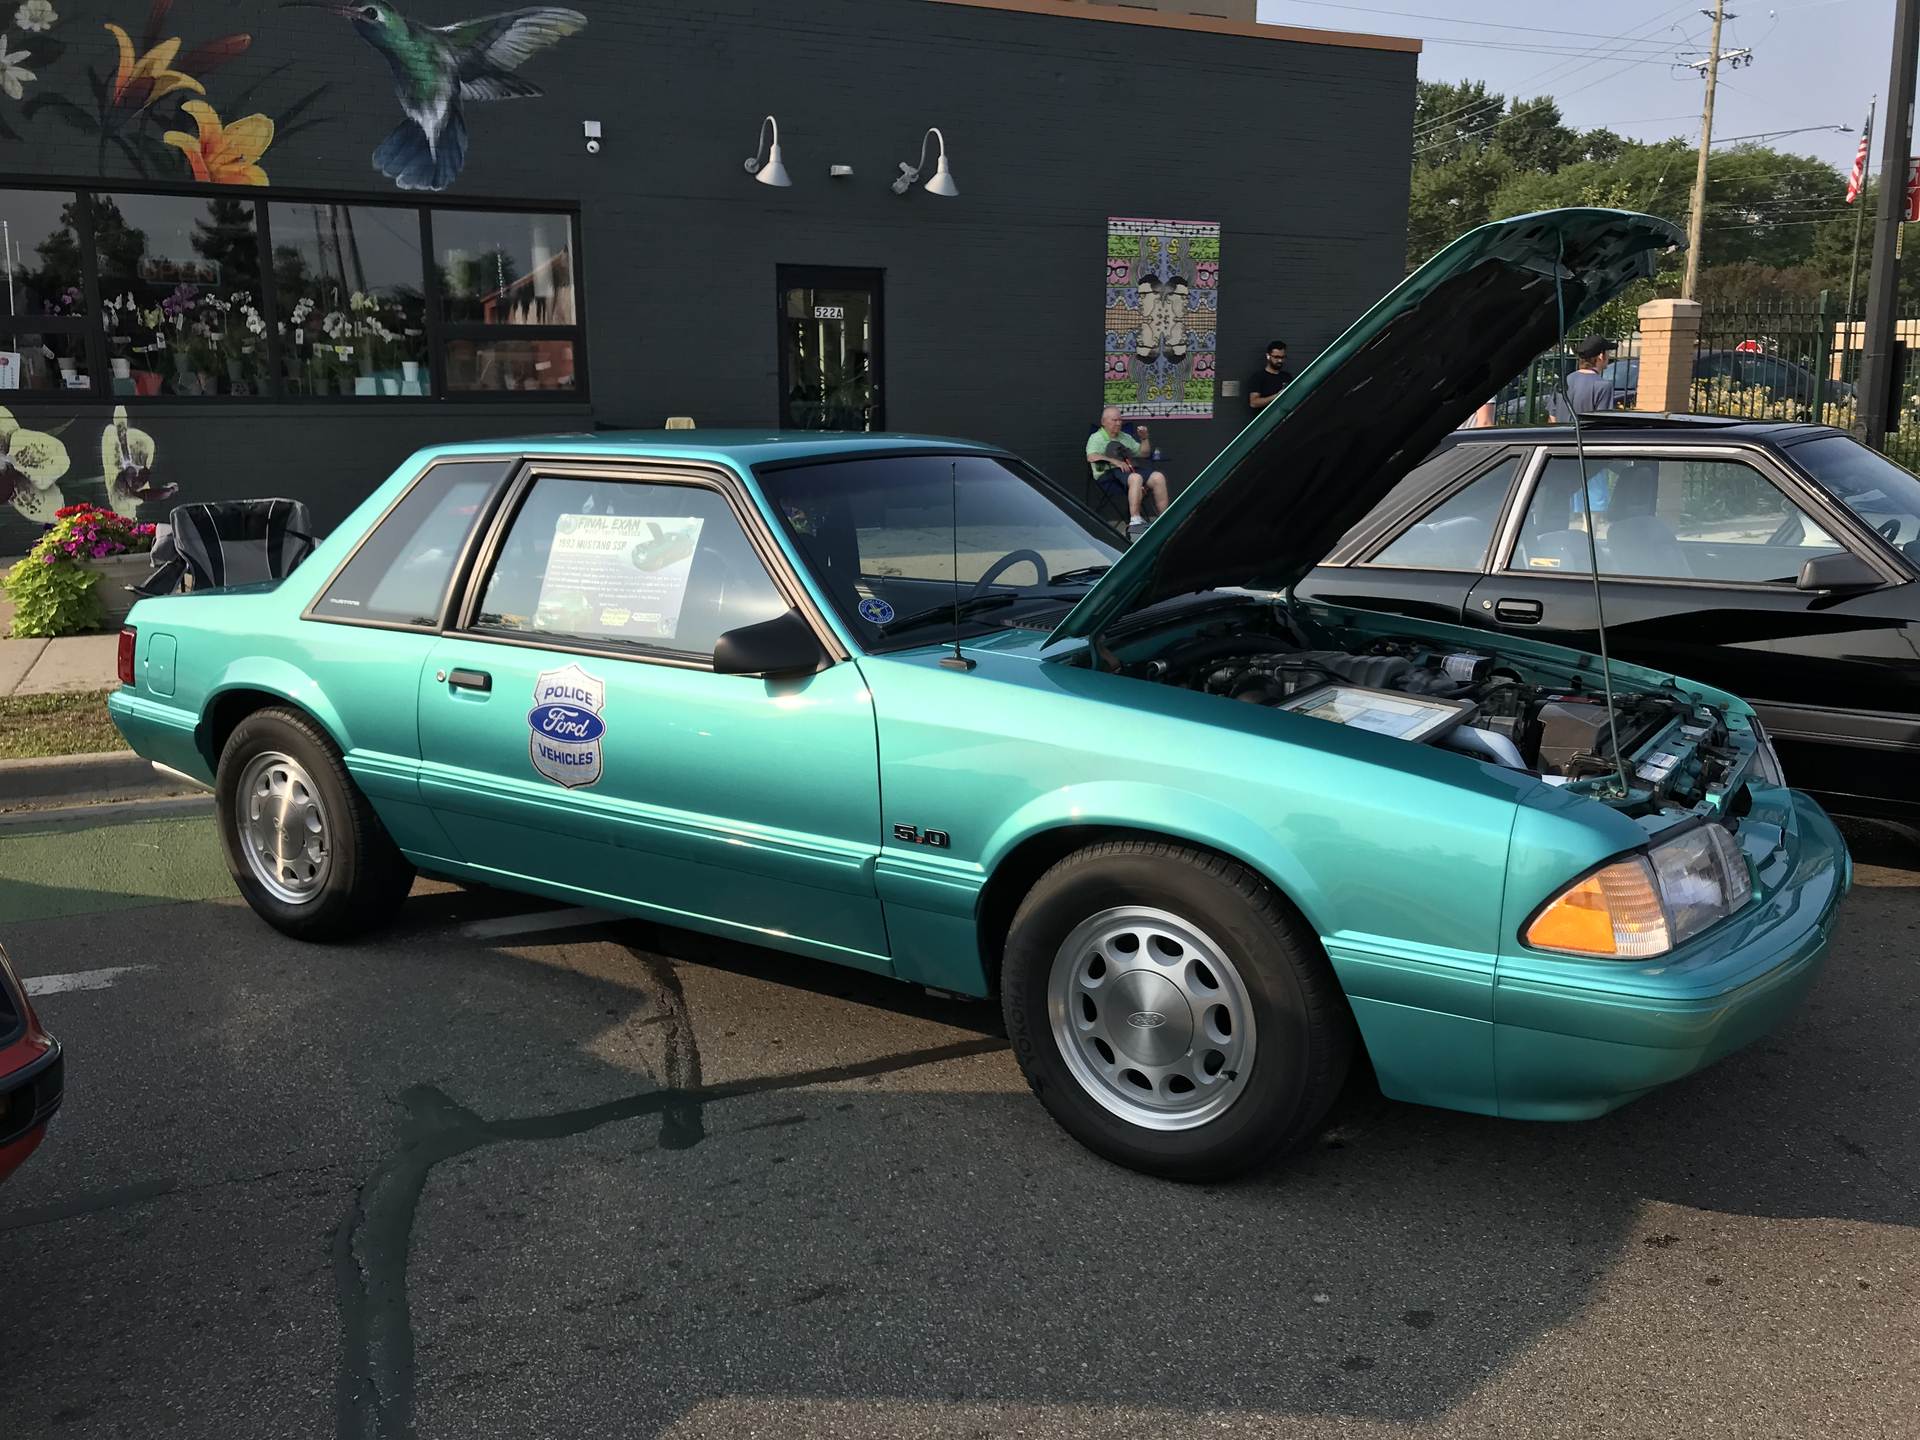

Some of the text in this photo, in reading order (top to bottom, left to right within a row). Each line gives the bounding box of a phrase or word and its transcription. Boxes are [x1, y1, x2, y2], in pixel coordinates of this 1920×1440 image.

[816, 308, 842, 318] 522A
[577, 518, 608, 529] FINAL
[577, 540, 611, 550] MUSTANG
[544, 686, 593, 706] POLICE
[543, 707, 589, 738] Ford
[538, 743, 593, 766] VEHICLES
[894, 823, 949, 848] 5.0
